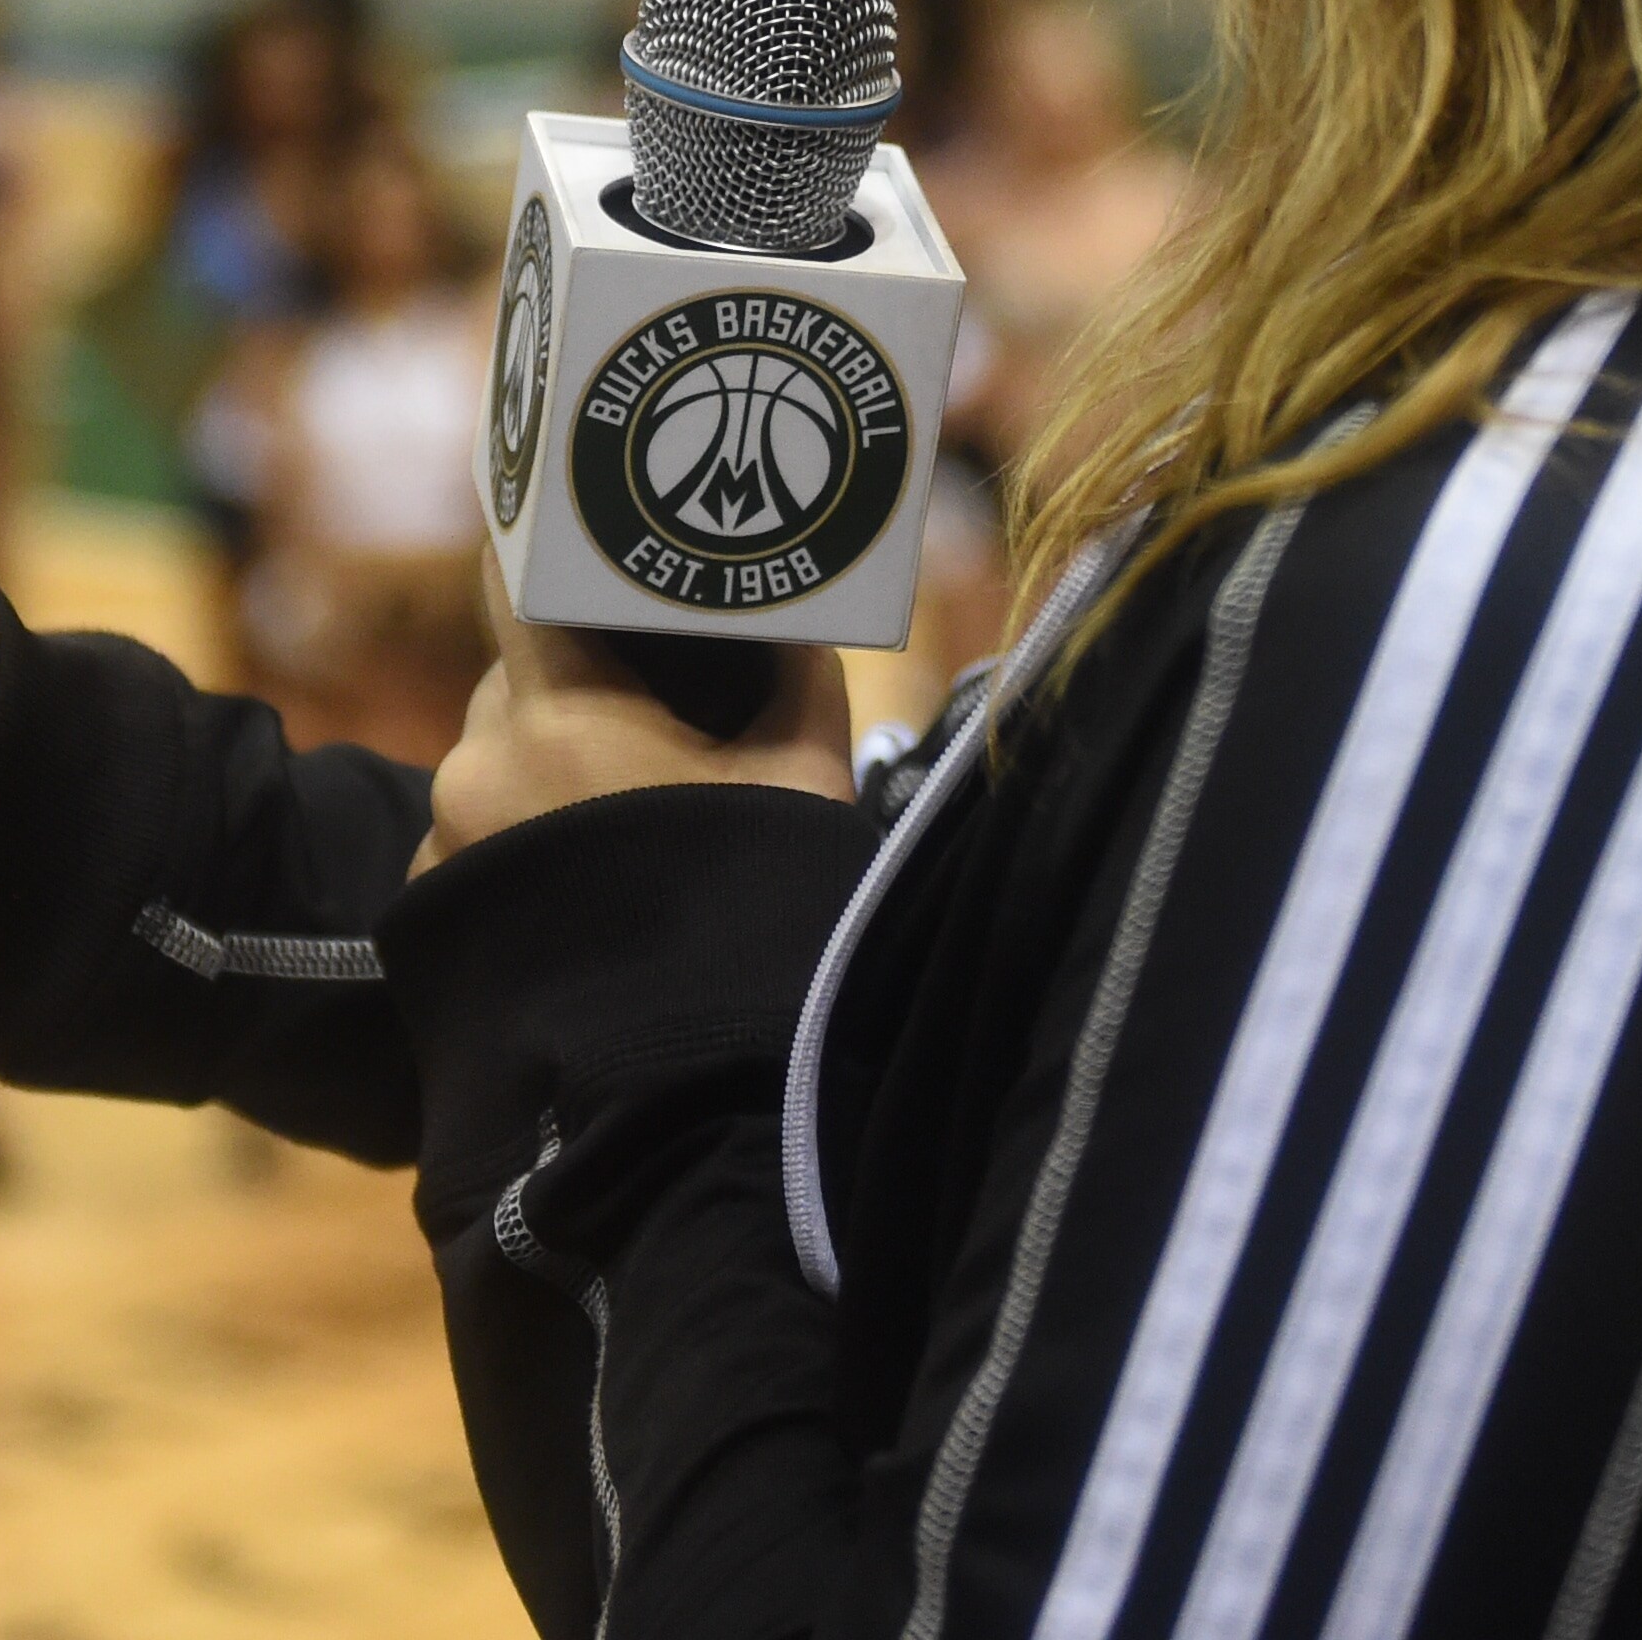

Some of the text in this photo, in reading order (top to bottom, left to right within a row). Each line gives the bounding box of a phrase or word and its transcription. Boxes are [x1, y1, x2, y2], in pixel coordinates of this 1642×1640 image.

[586, 299, 901, 448] BUCKS BASKETBALL
[622, 535, 822, 603] EST. 1968
